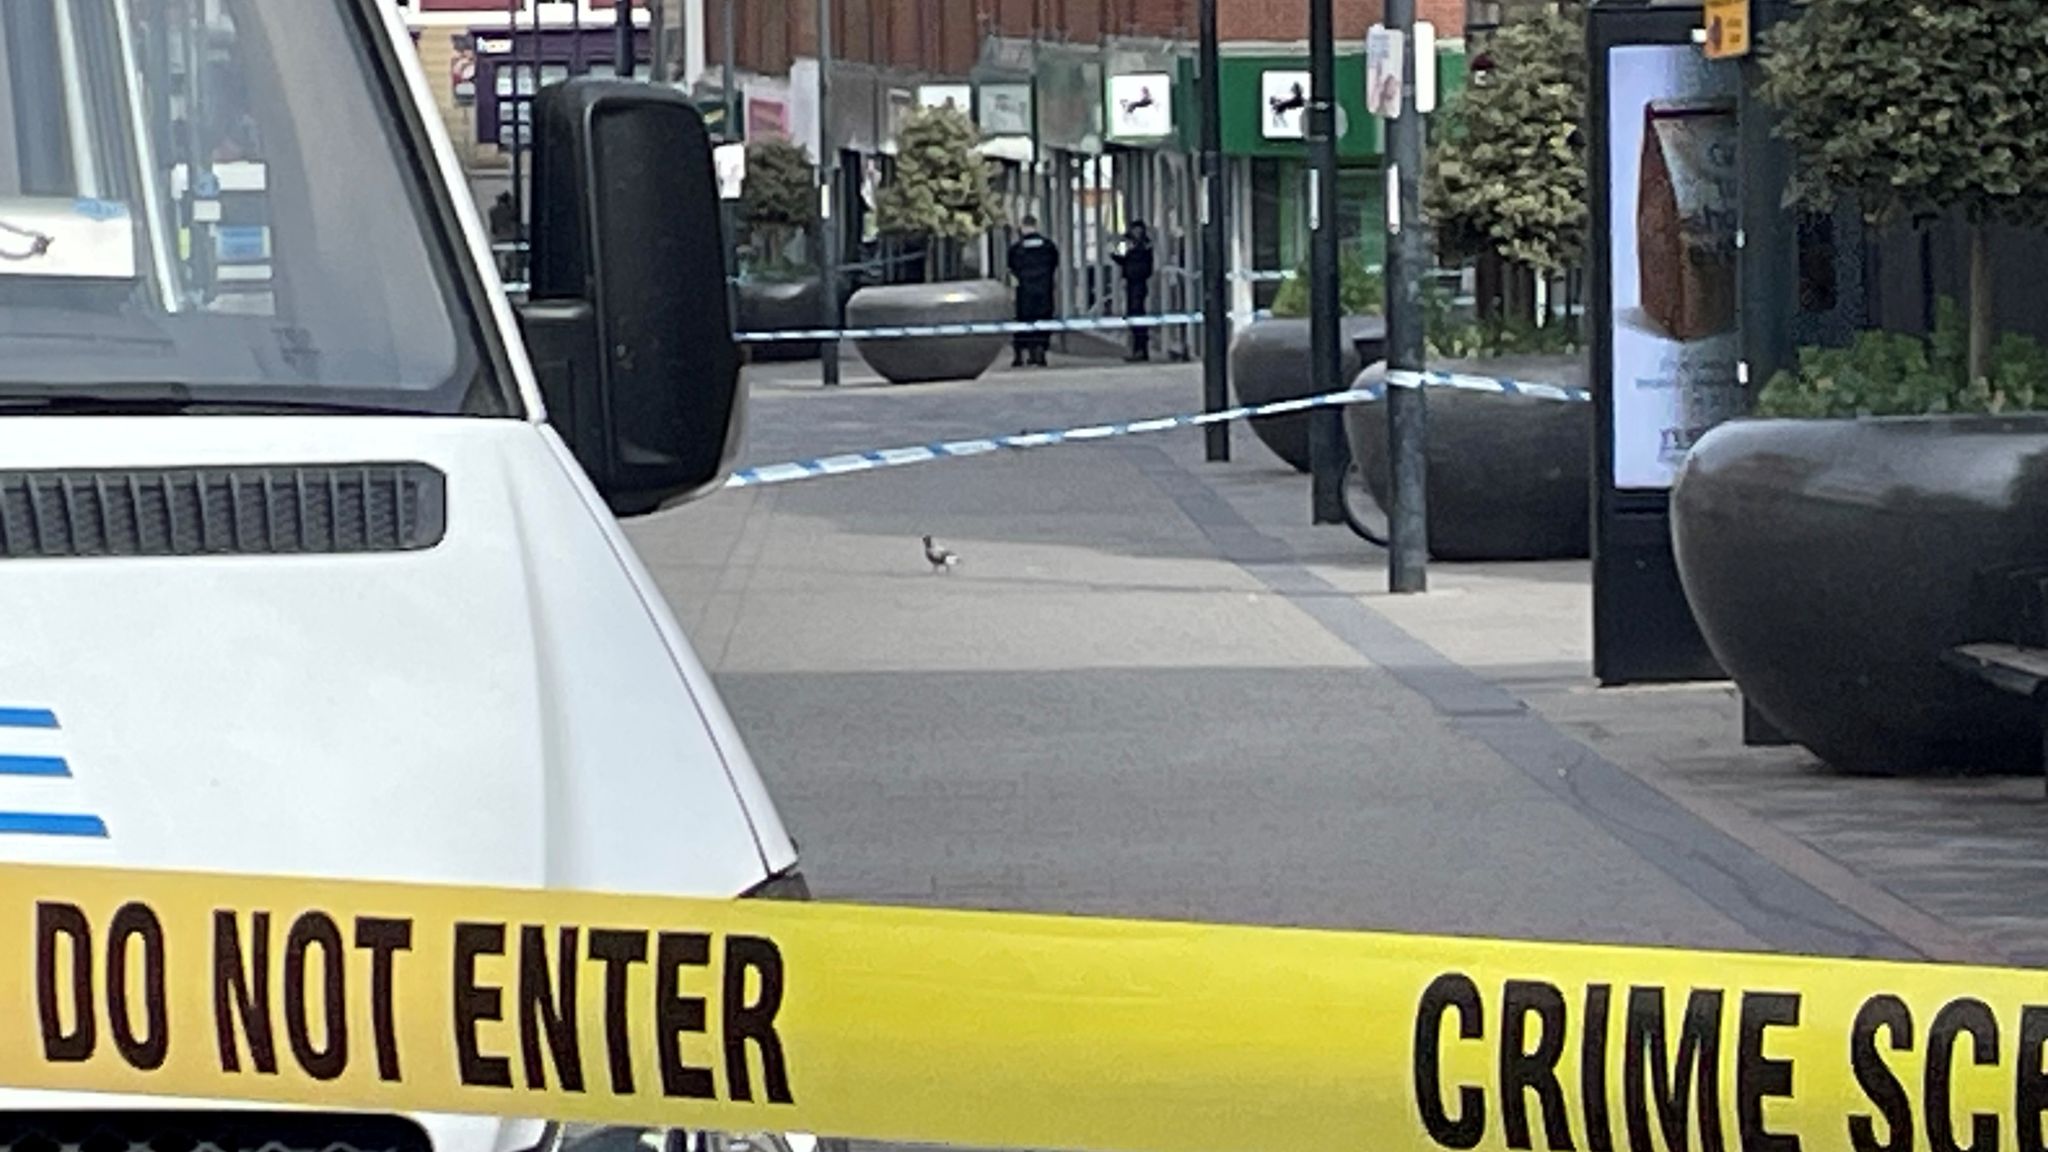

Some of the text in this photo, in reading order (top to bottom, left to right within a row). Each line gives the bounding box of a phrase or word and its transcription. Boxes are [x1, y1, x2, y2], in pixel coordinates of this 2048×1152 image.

[36, 900, 169, 1071] DO
[213, 910, 413, 1082] NOT
[453, 921, 796, 1105] ENTER
[1414, 972, 1802, 1152] CRIME
